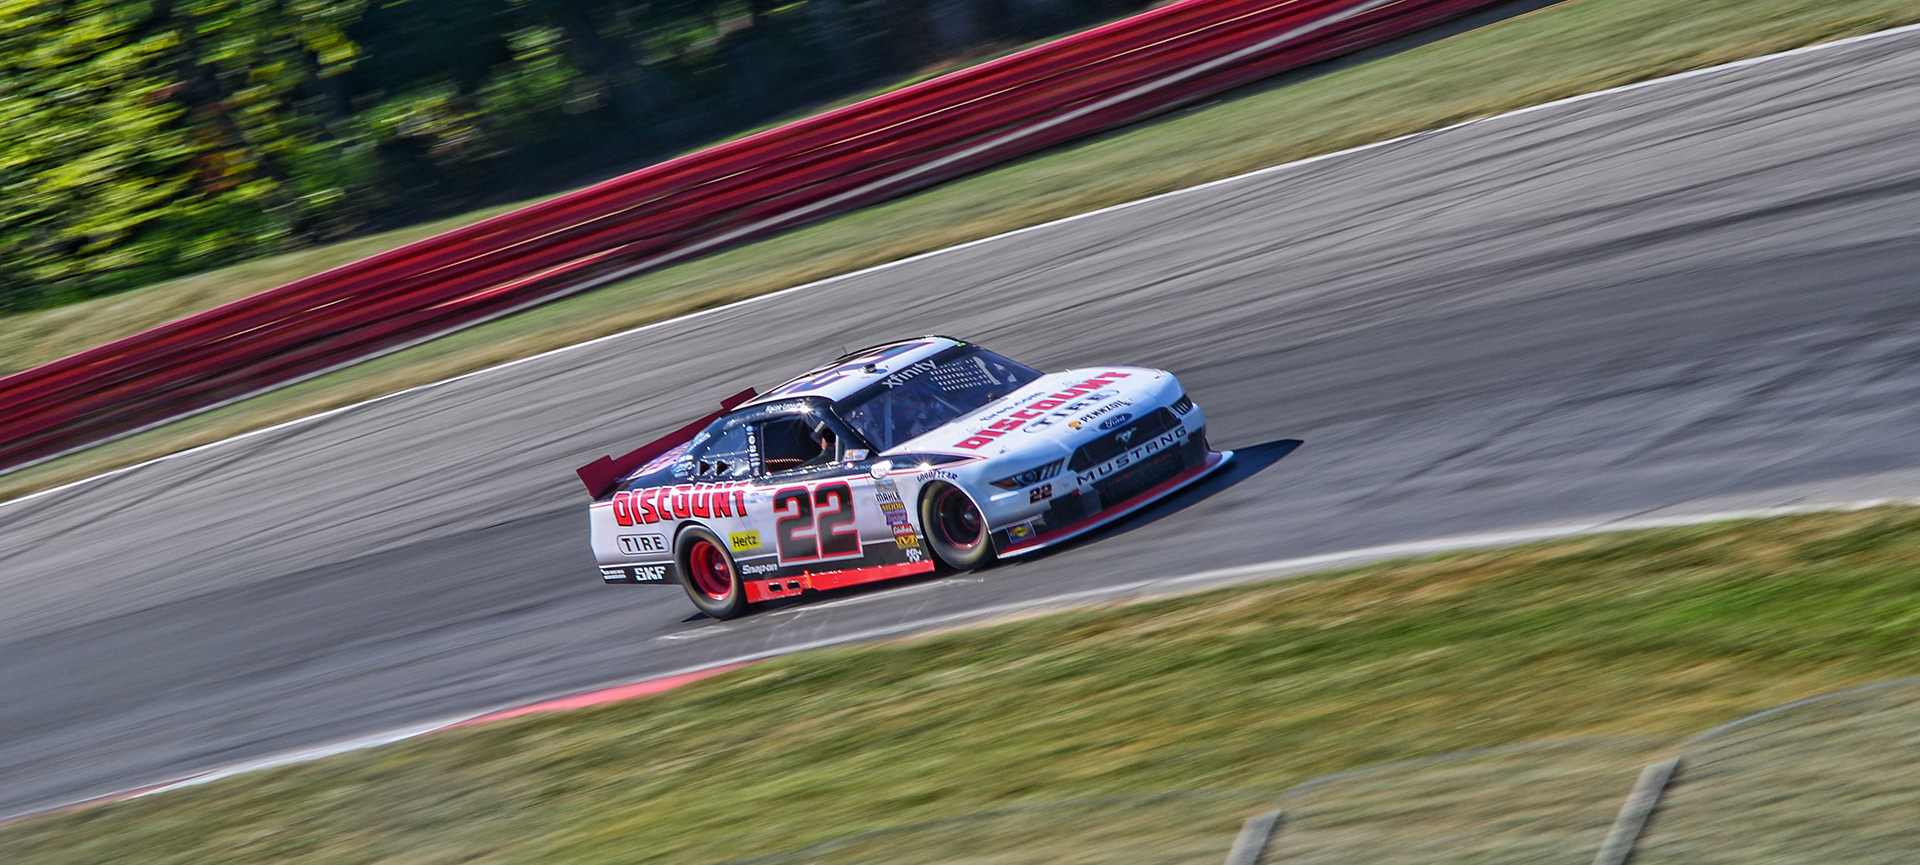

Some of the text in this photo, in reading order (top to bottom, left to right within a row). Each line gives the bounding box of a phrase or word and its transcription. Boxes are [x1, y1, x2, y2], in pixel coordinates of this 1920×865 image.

[882, 359, 938, 389] xfinity
[953, 371, 1131, 450] DISCOUNT
[1030, 391, 1112, 426] TIRE
[1075, 426, 1187, 486] MUSTANG
[612, 481, 750, 527] DISCOUNT
[1029, 483, 1053, 504] 22
[772, 480, 863, 567] 22
[620, 535, 665, 552] TIRE
[732, 536, 757, 549] Hertz
[633, 566, 667, 582] SKF
